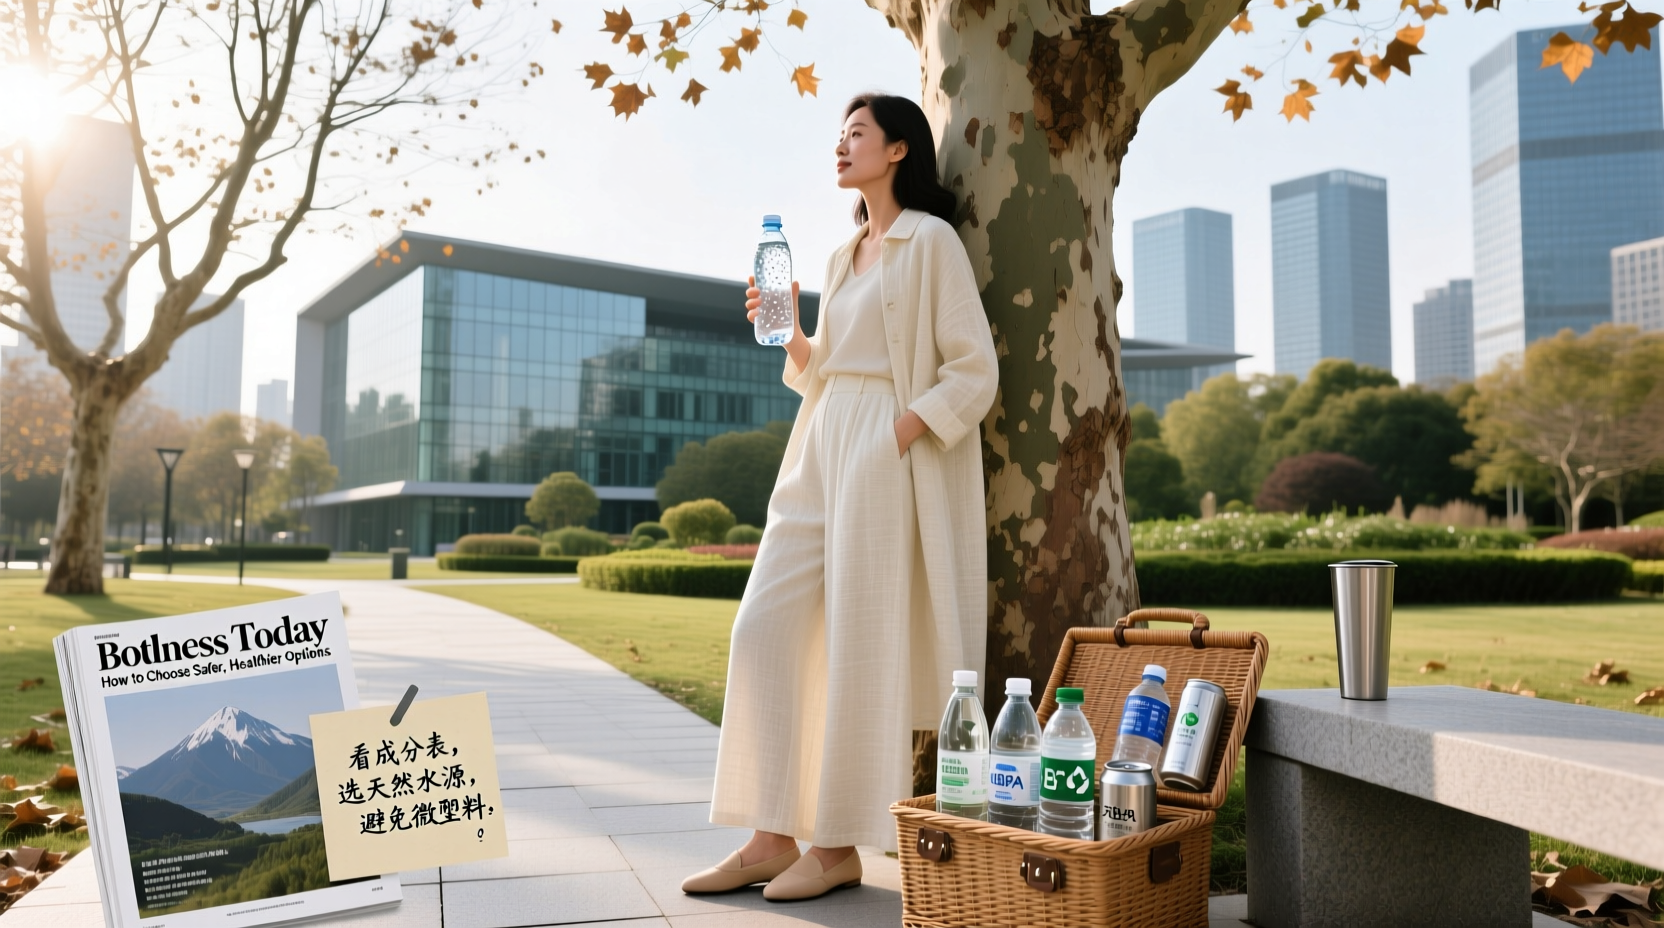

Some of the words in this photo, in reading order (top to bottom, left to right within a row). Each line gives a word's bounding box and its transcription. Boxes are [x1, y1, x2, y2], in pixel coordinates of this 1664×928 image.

[96, 633, 230, 671] Botlness
[230, 615, 329, 652] Today
[101, 676, 129, 688] How
[131, 672, 145, 684] to
[146, 668, 191, 682] Choose
[192, 662, 227, 676] Safer,
[229, 653, 282, 671] Healthier
[284, 647, 332, 665] Options
[349, 731, 458, 770] 看成分表，
[338, 764, 476, 804] 选天然水源，
